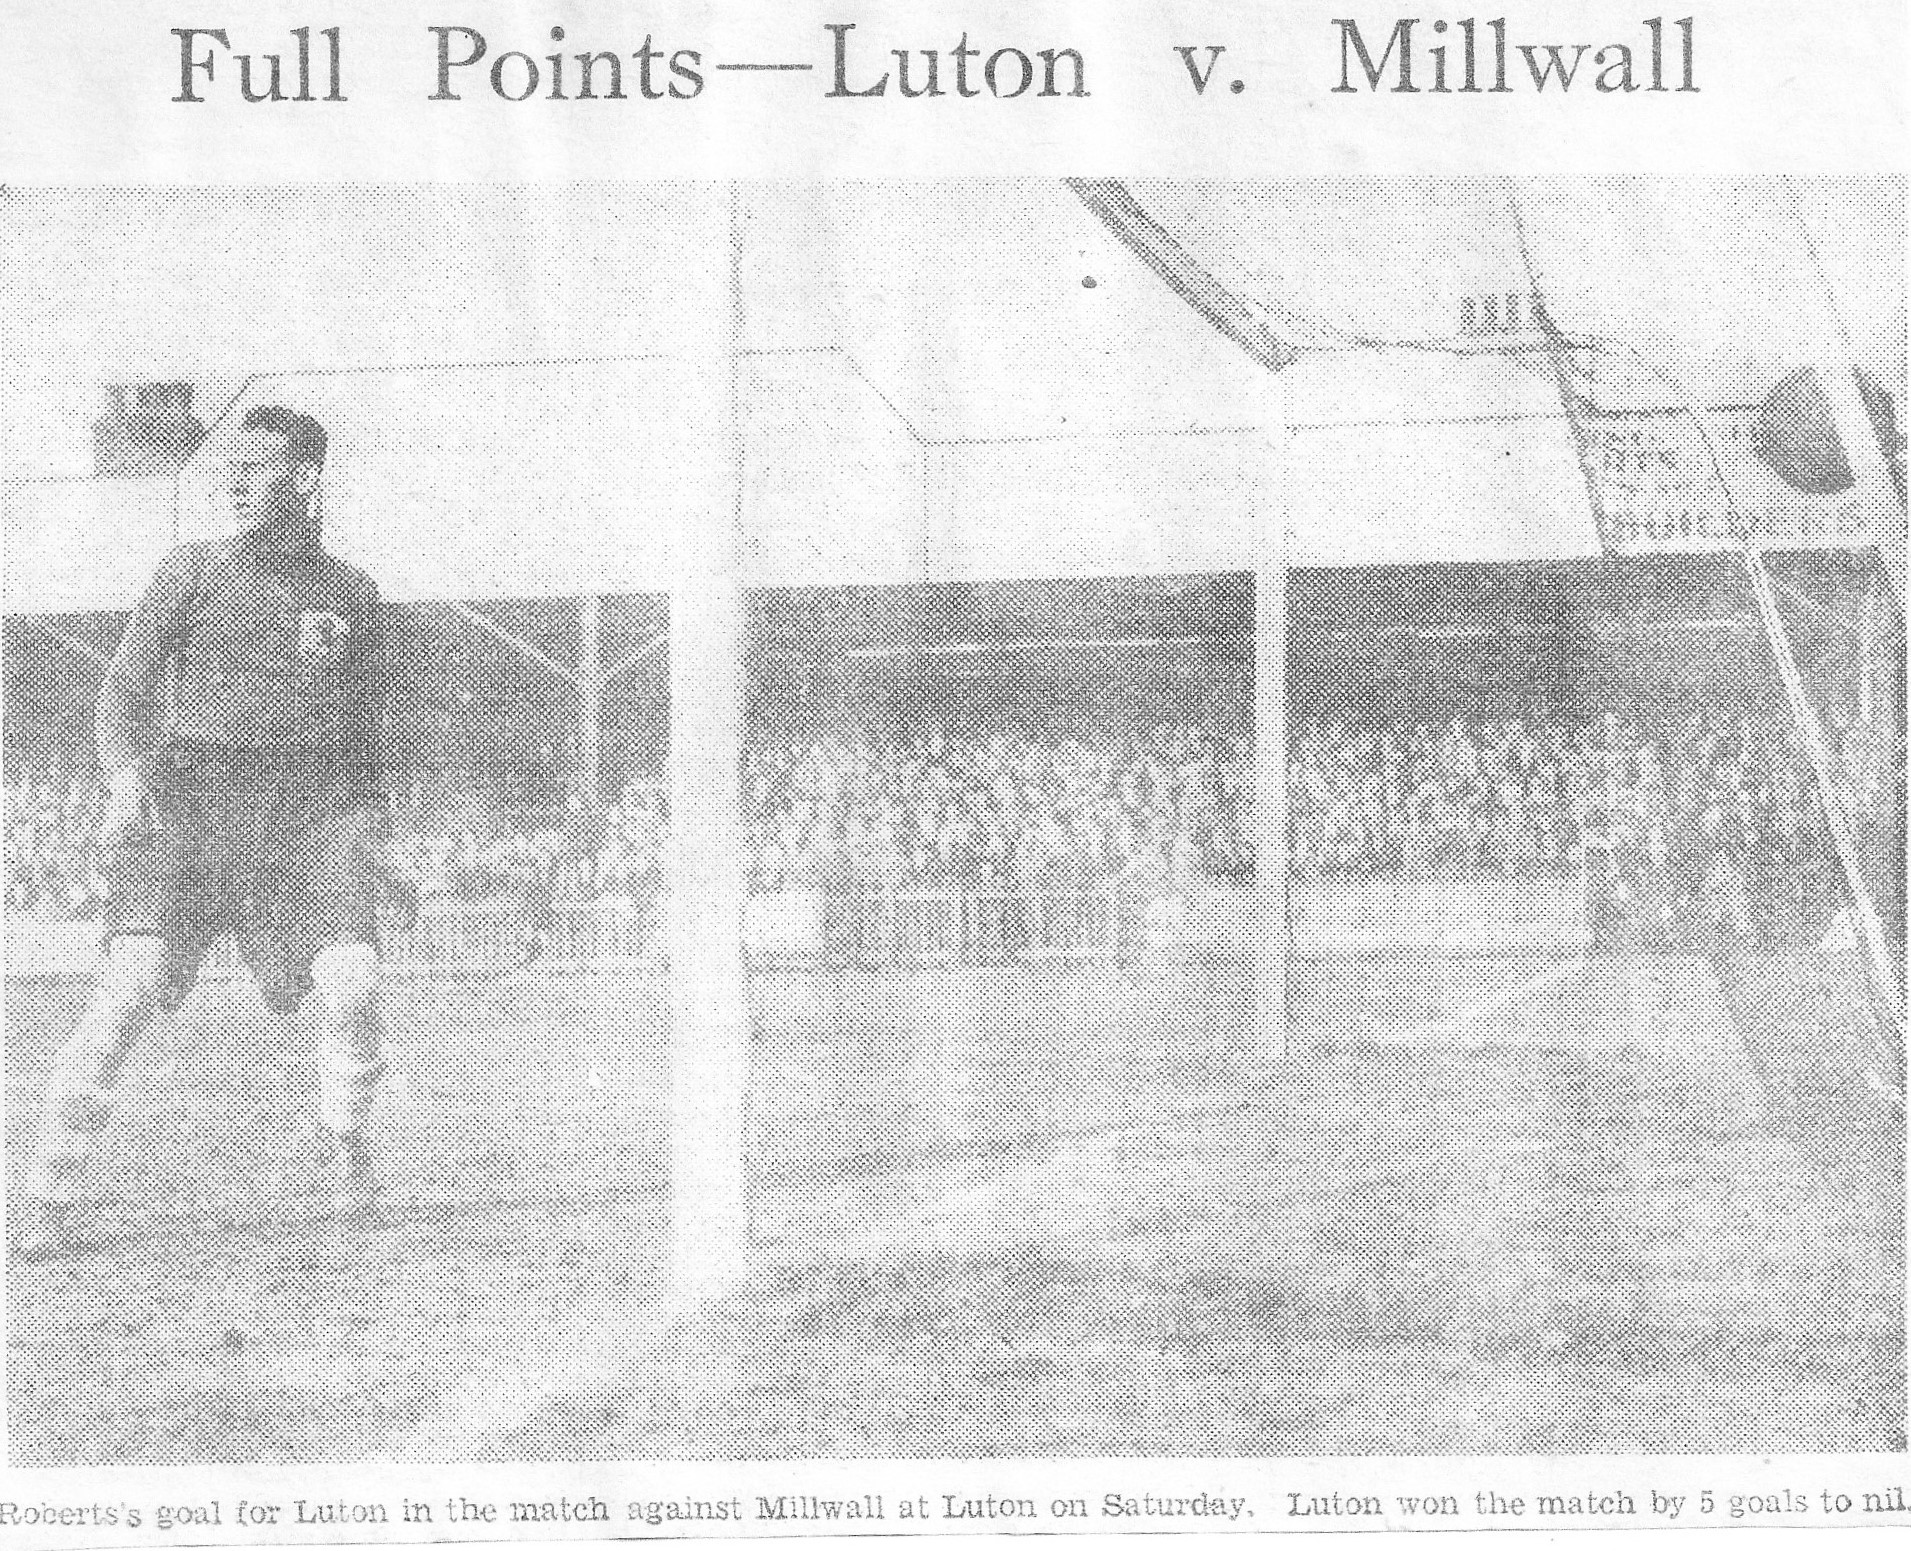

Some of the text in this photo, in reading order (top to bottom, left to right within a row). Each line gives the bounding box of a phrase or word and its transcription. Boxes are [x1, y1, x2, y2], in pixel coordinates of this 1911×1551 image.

[172, 27, 348, 103] Full
[1174, 45, 1245, 95] v.
[1332, 18, 1700, 93] Millwall
[157, 1502, 222, 1530] goal
[236, 1502, 281, 1527] for
[295, 1501, 389, 1525] Luton
[403, 1499, 433, 1523] in
[446, 1498, 498, 1523] the
[510, 1497, 610, 1522] match
[627, 1498, 742, 1526] against
[756, 1496, 885, 1521] Millwall
[899, 1498, 929, 1520] at
[943, 1495, 1036, 1519] Luton
[1051, 1501, 1088, 1518] on
[1288, 1492, 1383, 1517] Luton
[1397, 1496, 1459, 1516] won
[1476, 1490, 1526, 1516] the
[1536, 1490, 1637, 1515] match
[1651, 1490, 1686, 1521] by
[1701, 1490, 1714, 1514] 5
[1730, 1489, 1809, 1519] goals
[1820, 1489, 1853, 1514] to
